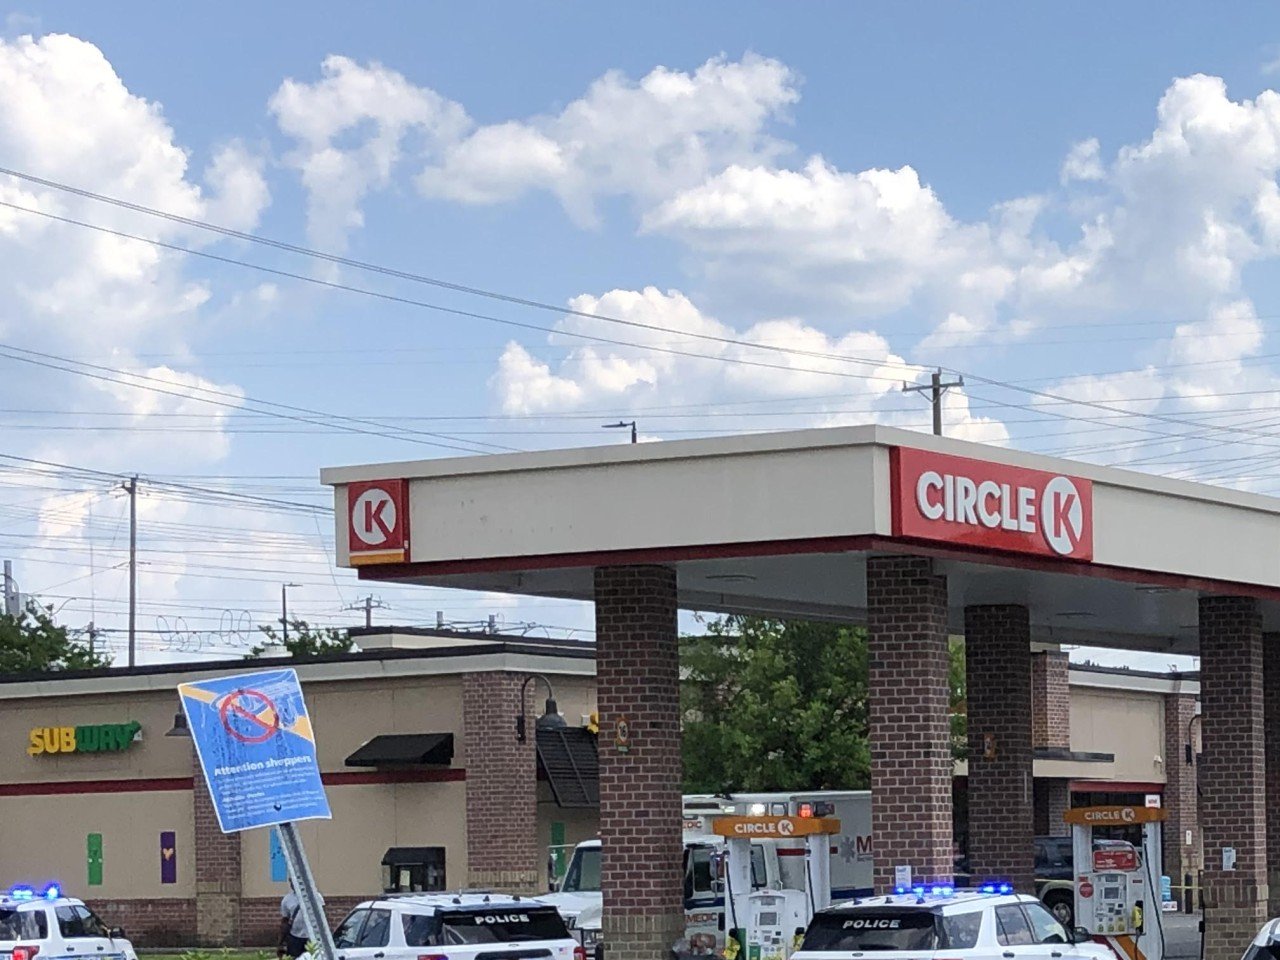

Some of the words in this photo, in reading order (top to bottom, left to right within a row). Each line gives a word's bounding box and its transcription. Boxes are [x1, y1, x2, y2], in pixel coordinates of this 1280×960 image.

[916, 471, 1036, 533] CIRCLE
[27, 721, 141, 757] SUBWAY
[214, 761, 264, 776] Attention
[265, 755, 312, 770] shoppers
[1084, 810, 1120, 820] CIRCLE
[1121, 808, 1135, 821] K
[734, 822, 776, 834] CIRCLE
[779, 820, 794, 835] K
[475, 914, 530, 925] POLICE
[686, 913, 717, 923] MEDIC
[842, 919, 901, 929] POLICE
